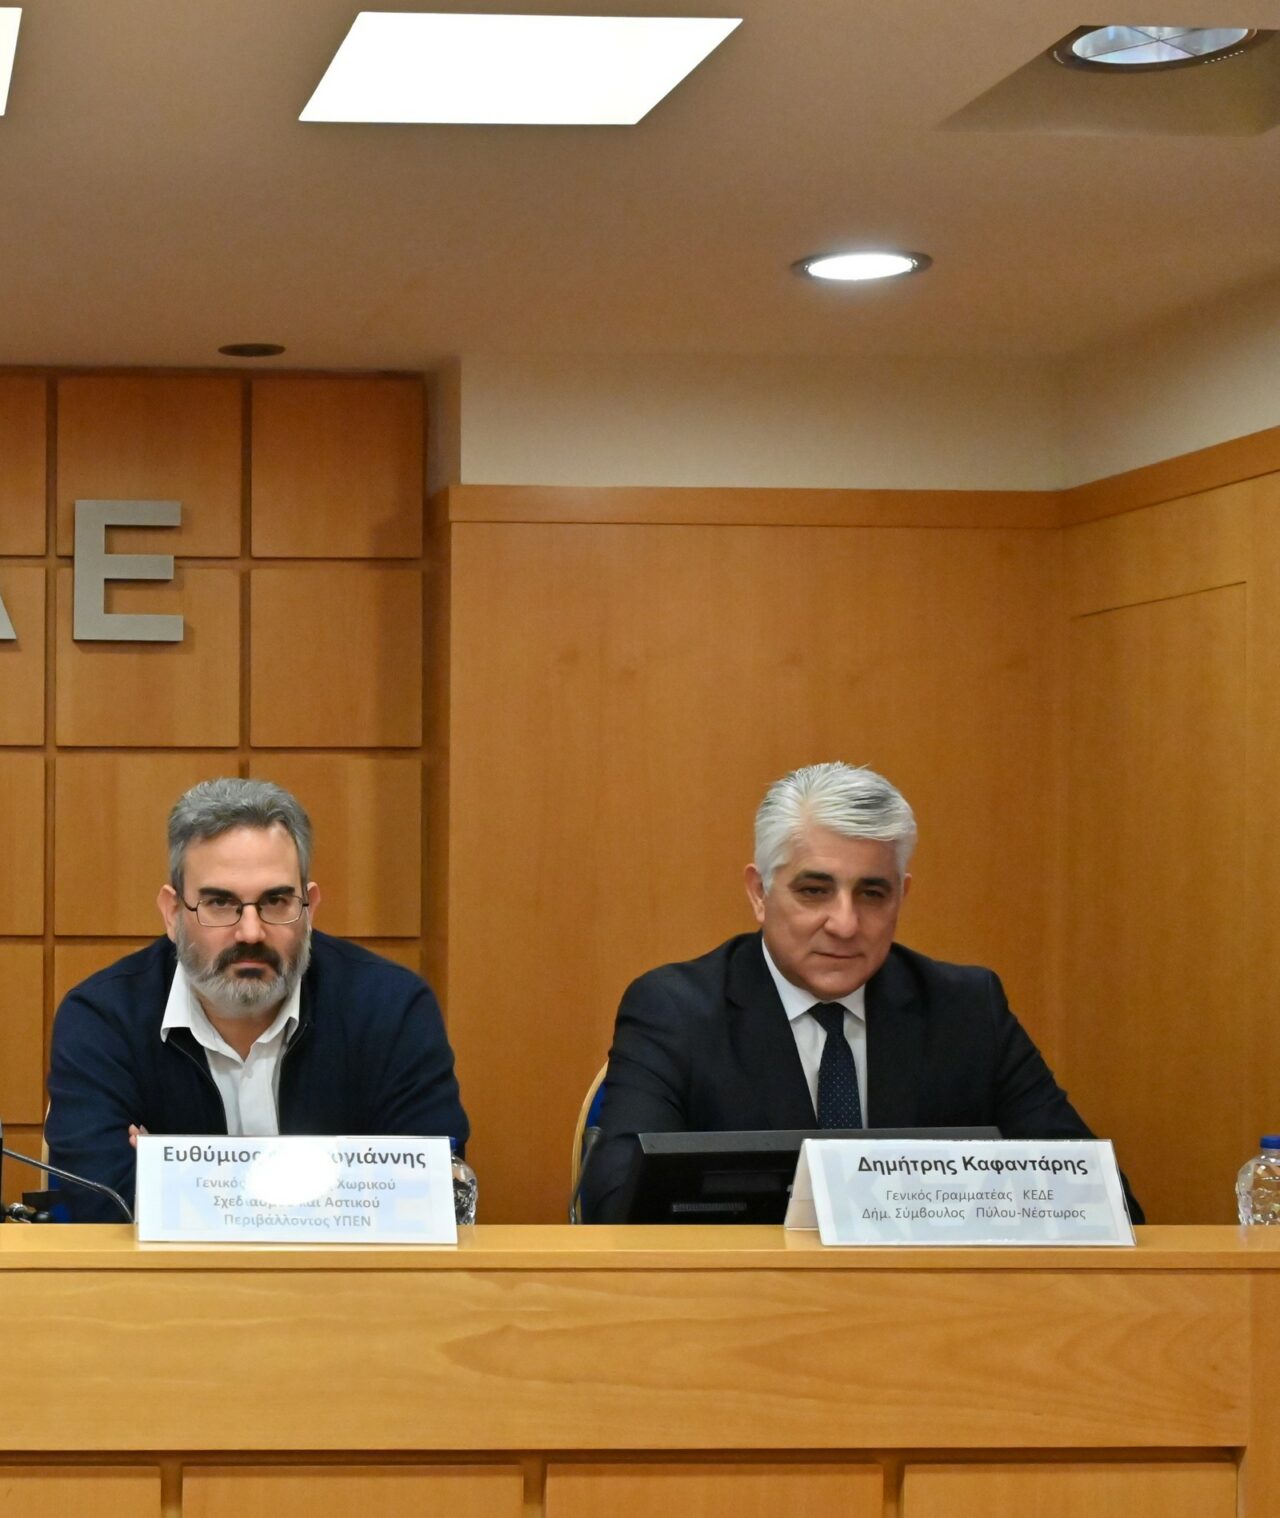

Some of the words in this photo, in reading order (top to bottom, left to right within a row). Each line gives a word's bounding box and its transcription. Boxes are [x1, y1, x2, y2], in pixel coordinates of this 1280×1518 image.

[330, 1147, 427, 1168] ογιάννης
[858, 1156, 957, 1175] Δημήτρης
[962, 1156, 1088, 1175] Καφαντάρης
[337, 1178, 396, 1192] Χωρικού
[213, 1195, 293, 1209] Σχεδια
[325, 1196, 380, 1208] Αστικού
[887, 1190, 932, 1202] Γενικός
[936, 1189, 1012, 1202] Γραμματέας
[1023, 1190, 1053, 1200] ΚΕΔΕ
[224, 1212, 330, 1229] Περιβάλλοντος
[333, 1215, 371, 1227] ΥΠΕΝ
[862, 1208, 891, 1221] Δήμ.
[895, 1207, 965, 1220] Σύμβουλος
[976, 1206, 1086, 1220] Πύλου-Νέστωρος
